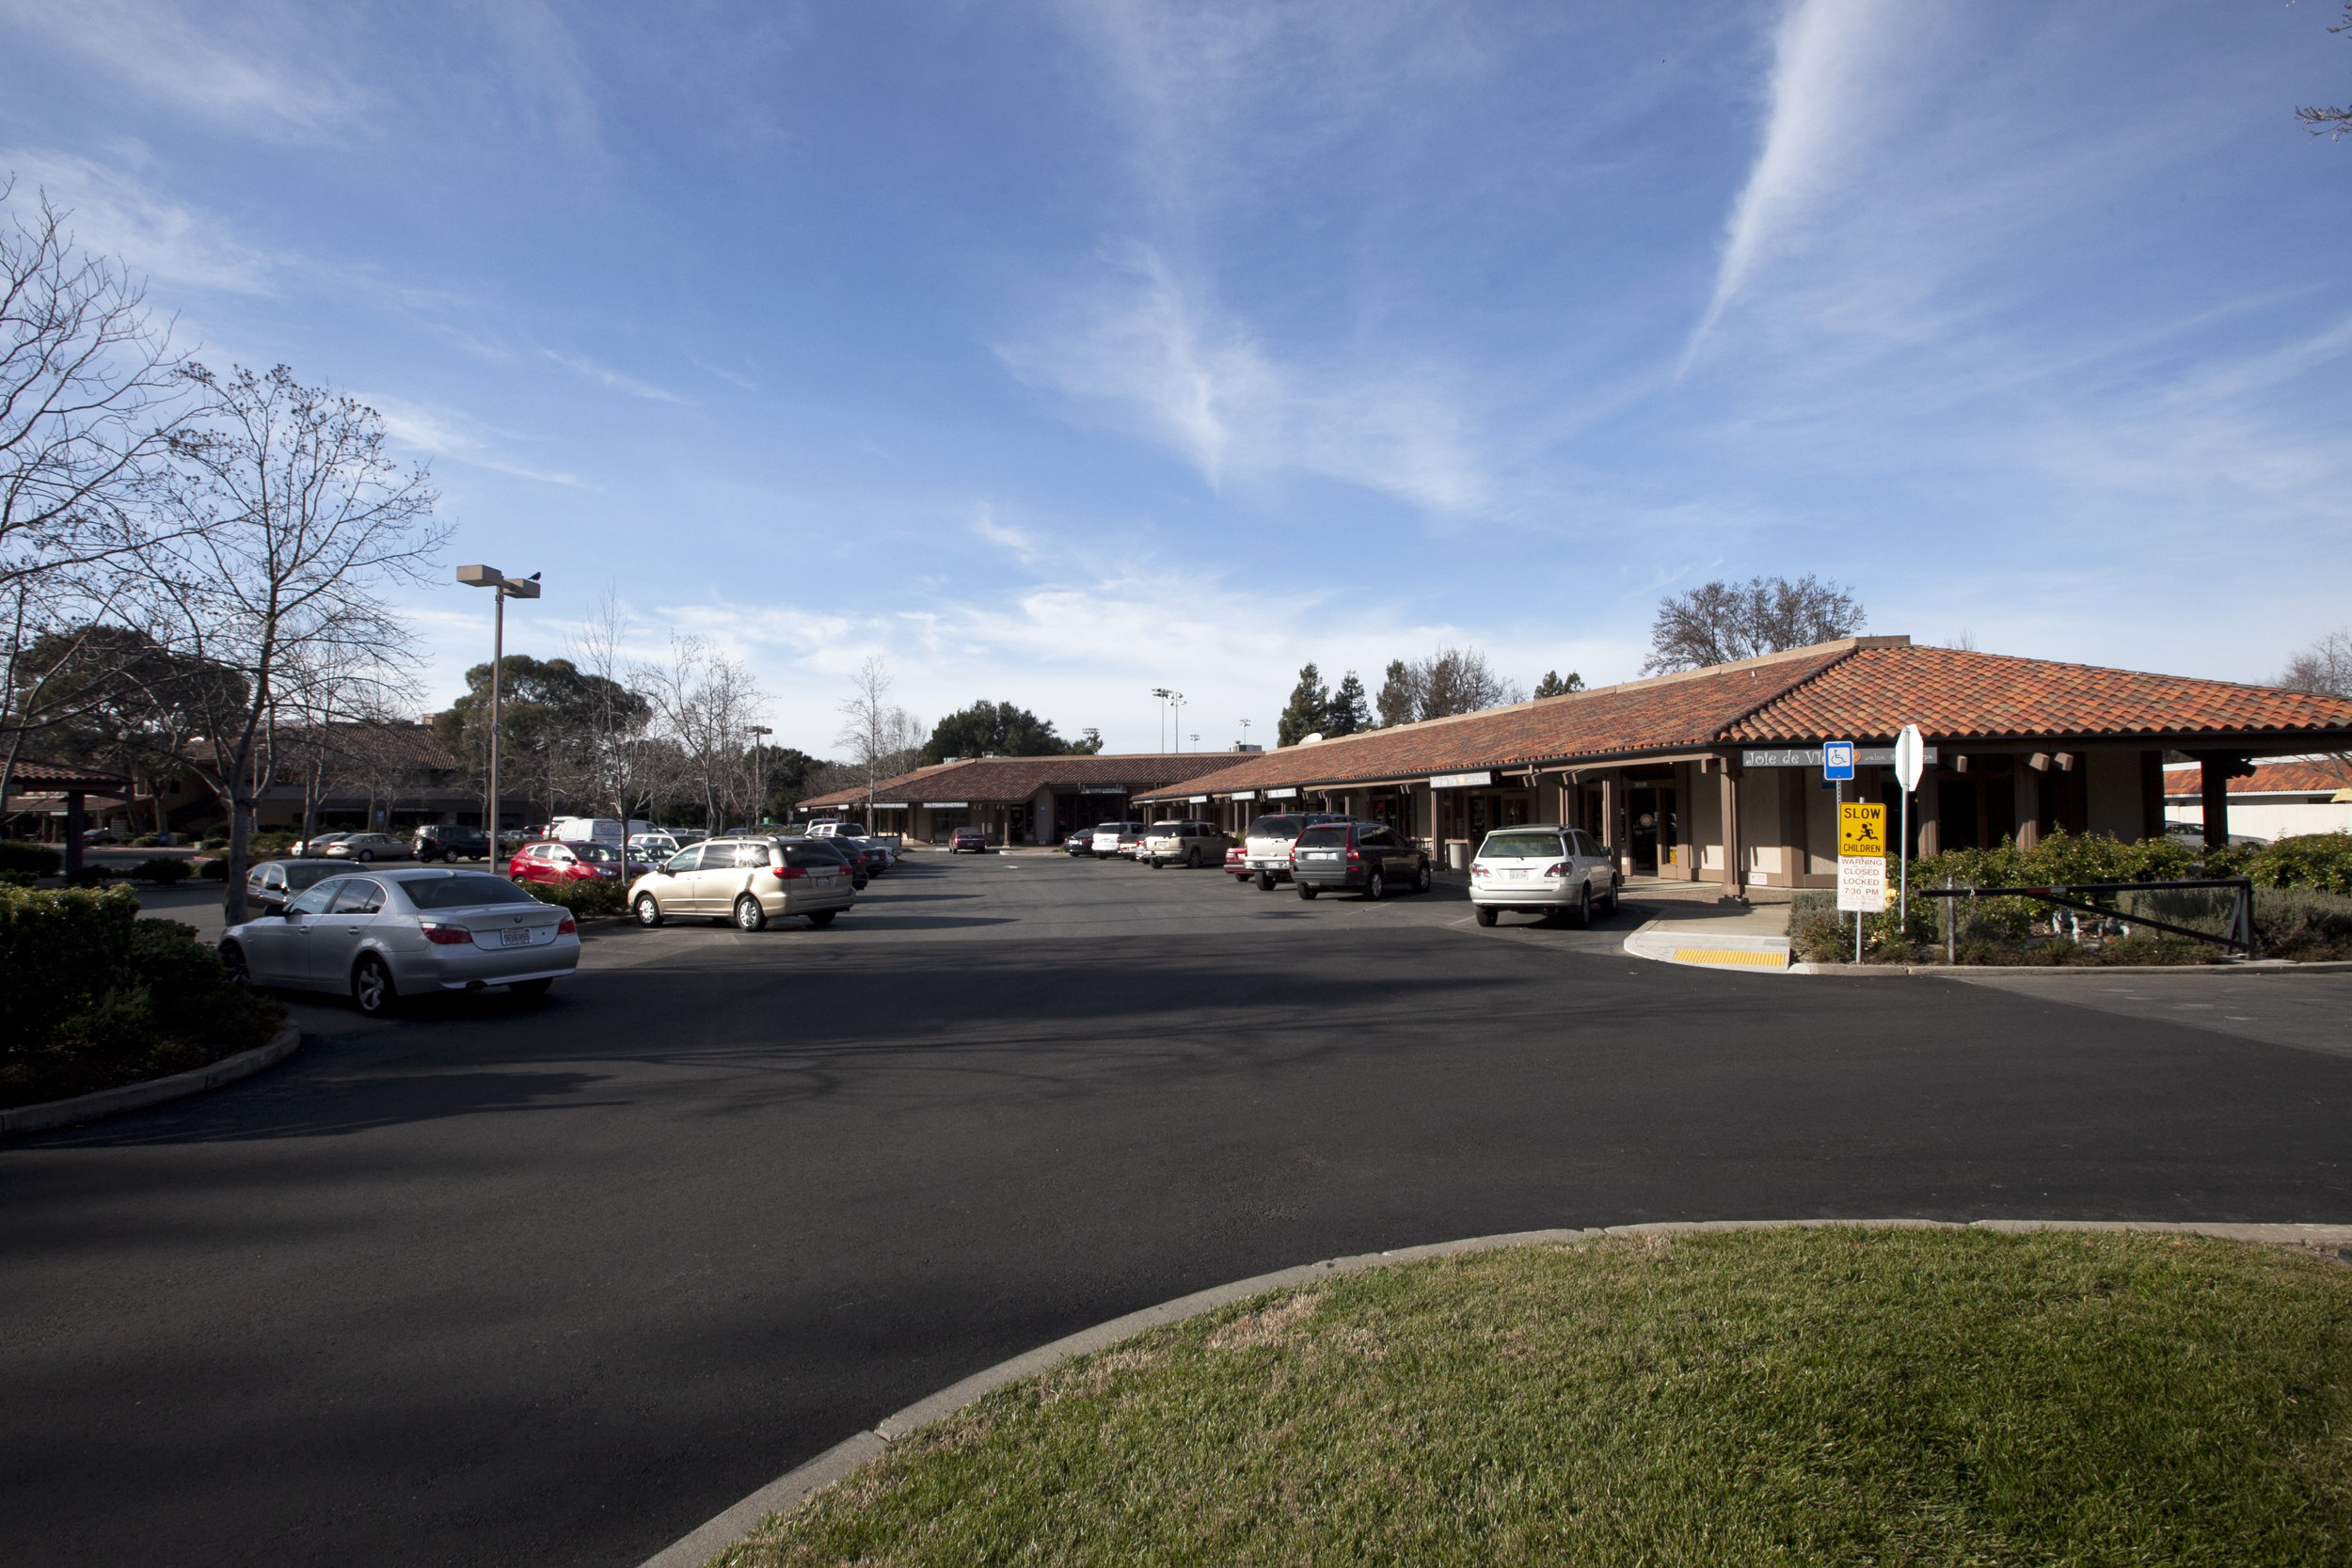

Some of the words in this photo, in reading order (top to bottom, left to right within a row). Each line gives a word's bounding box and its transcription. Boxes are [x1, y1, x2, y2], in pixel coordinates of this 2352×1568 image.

[1746, 752, 1777, 767] Joie
[1783, 750, 1800, 765] de
[1844, 808, 1881, 819] SLOW
[1843, 844, 1881, 852] CHILDREN
